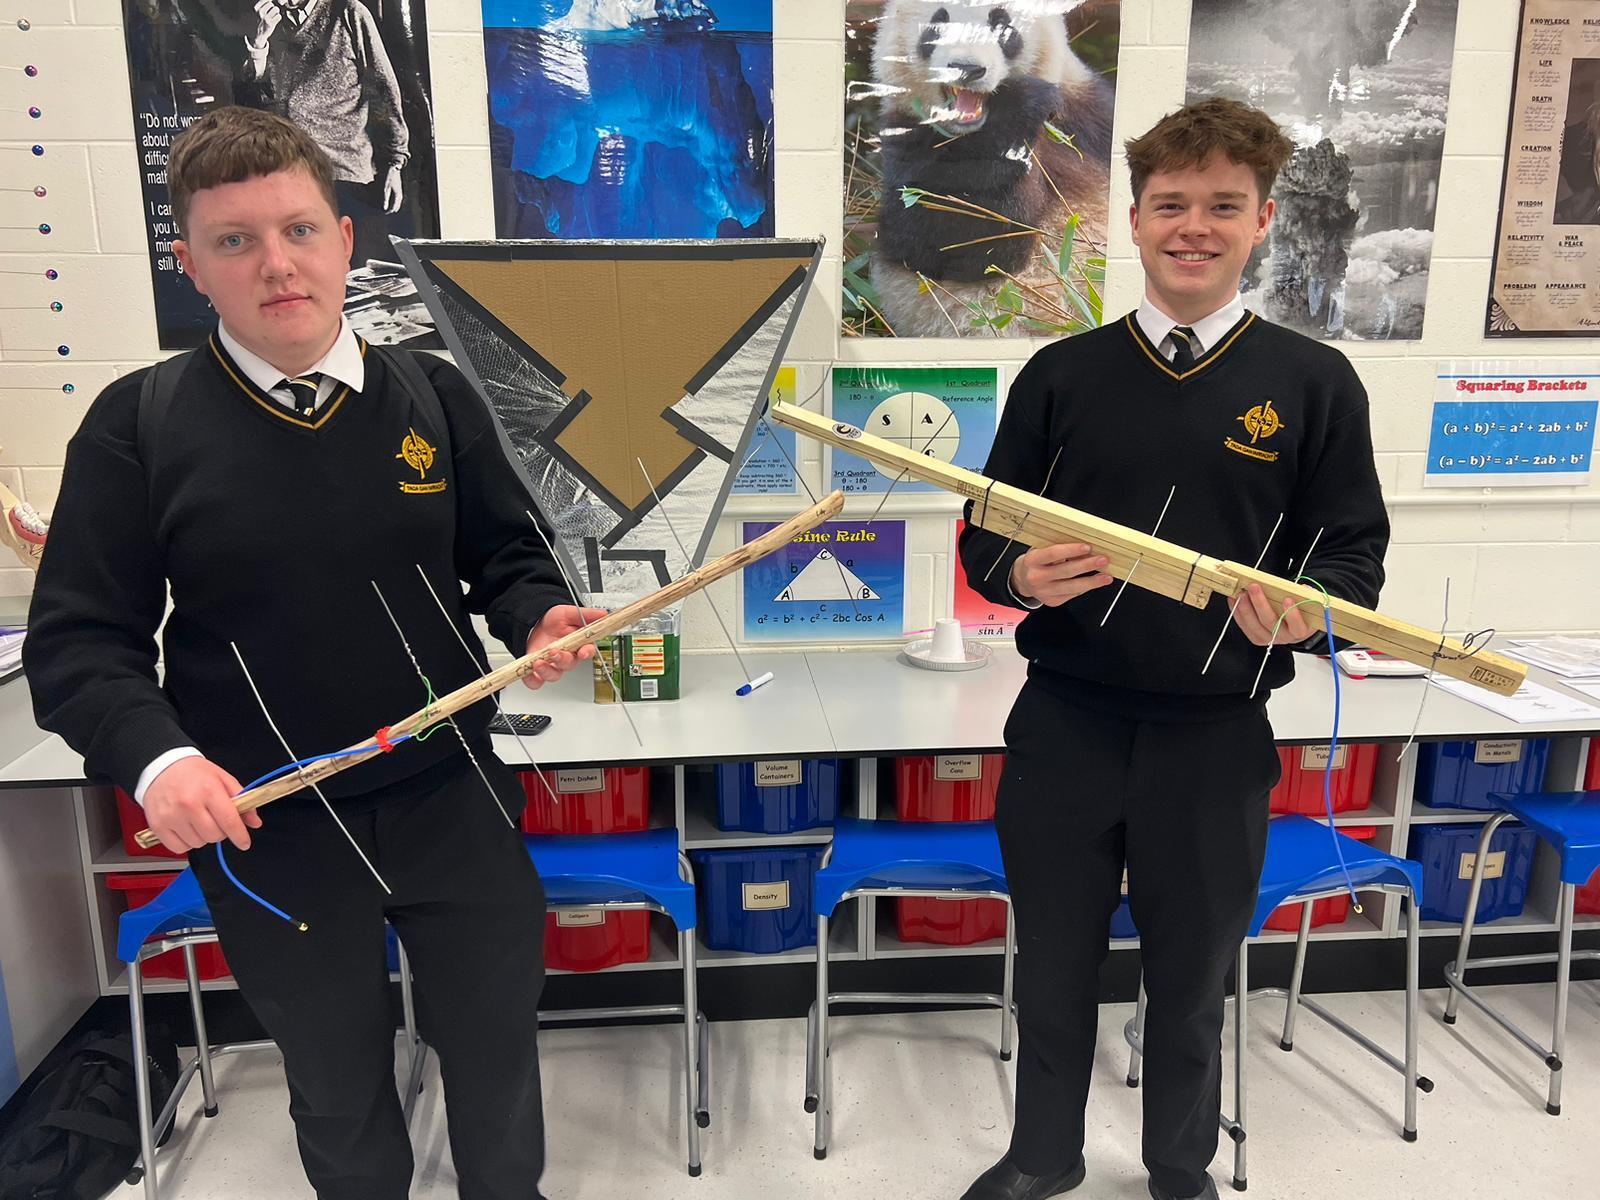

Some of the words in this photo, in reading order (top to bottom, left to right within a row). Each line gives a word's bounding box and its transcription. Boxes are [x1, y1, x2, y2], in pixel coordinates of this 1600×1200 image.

[163, 114, 178, 129] not
[142, 135, 169, 147] about
[150, 202, 154, 215] I
[153, 223, 170, 237] you
[158, 257, 174, 271] still
[1456, 379, 1525, 393] Squaring
[1527, 379, 1588, 391] Brackets
[882, 414, 891, 426] S
[921, 413, 933, 424] A
[1538, 422, 1561, 433] 2ab
[1533, 455, 1556, 465] 2ab
[836, 529, 877, 542] Rule
[820, 551, 827, 559] C
[790, 563, 798, 573] b
[781, 590, 790, 600] A
[862, 588, 871, 598] B
[832, 614, 850, 623] 2bc
[855, 613, 872, 622] Cos
[877, 614, 885, 622] A
[978, 627, 994, 635] sin
[996, 626, 1003, 635] A
